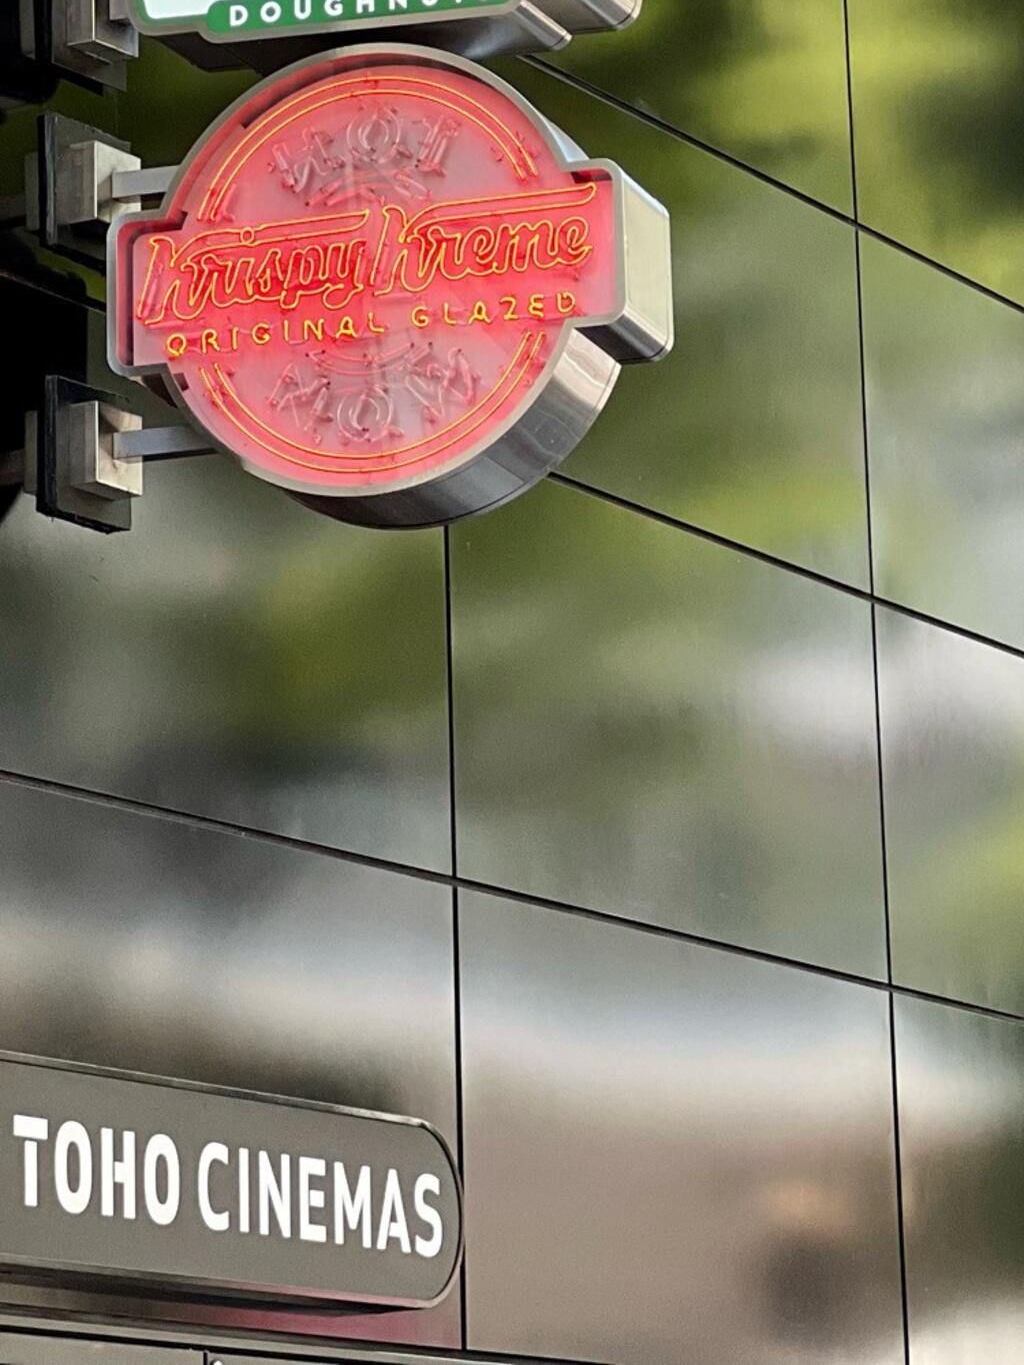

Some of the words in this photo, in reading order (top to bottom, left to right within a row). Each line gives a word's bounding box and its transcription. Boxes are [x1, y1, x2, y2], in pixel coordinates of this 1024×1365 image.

[137, 209, 370, 325] Krispy
[370, 182, 597, 296] Kreme
[165, 312, 386, 357] ORIGINAL
[411, 291, 577, 326] GLAZED
[12, 1114, 181, 1226] TOHO
[197, 1142, 444, 1258] CINEMAS
